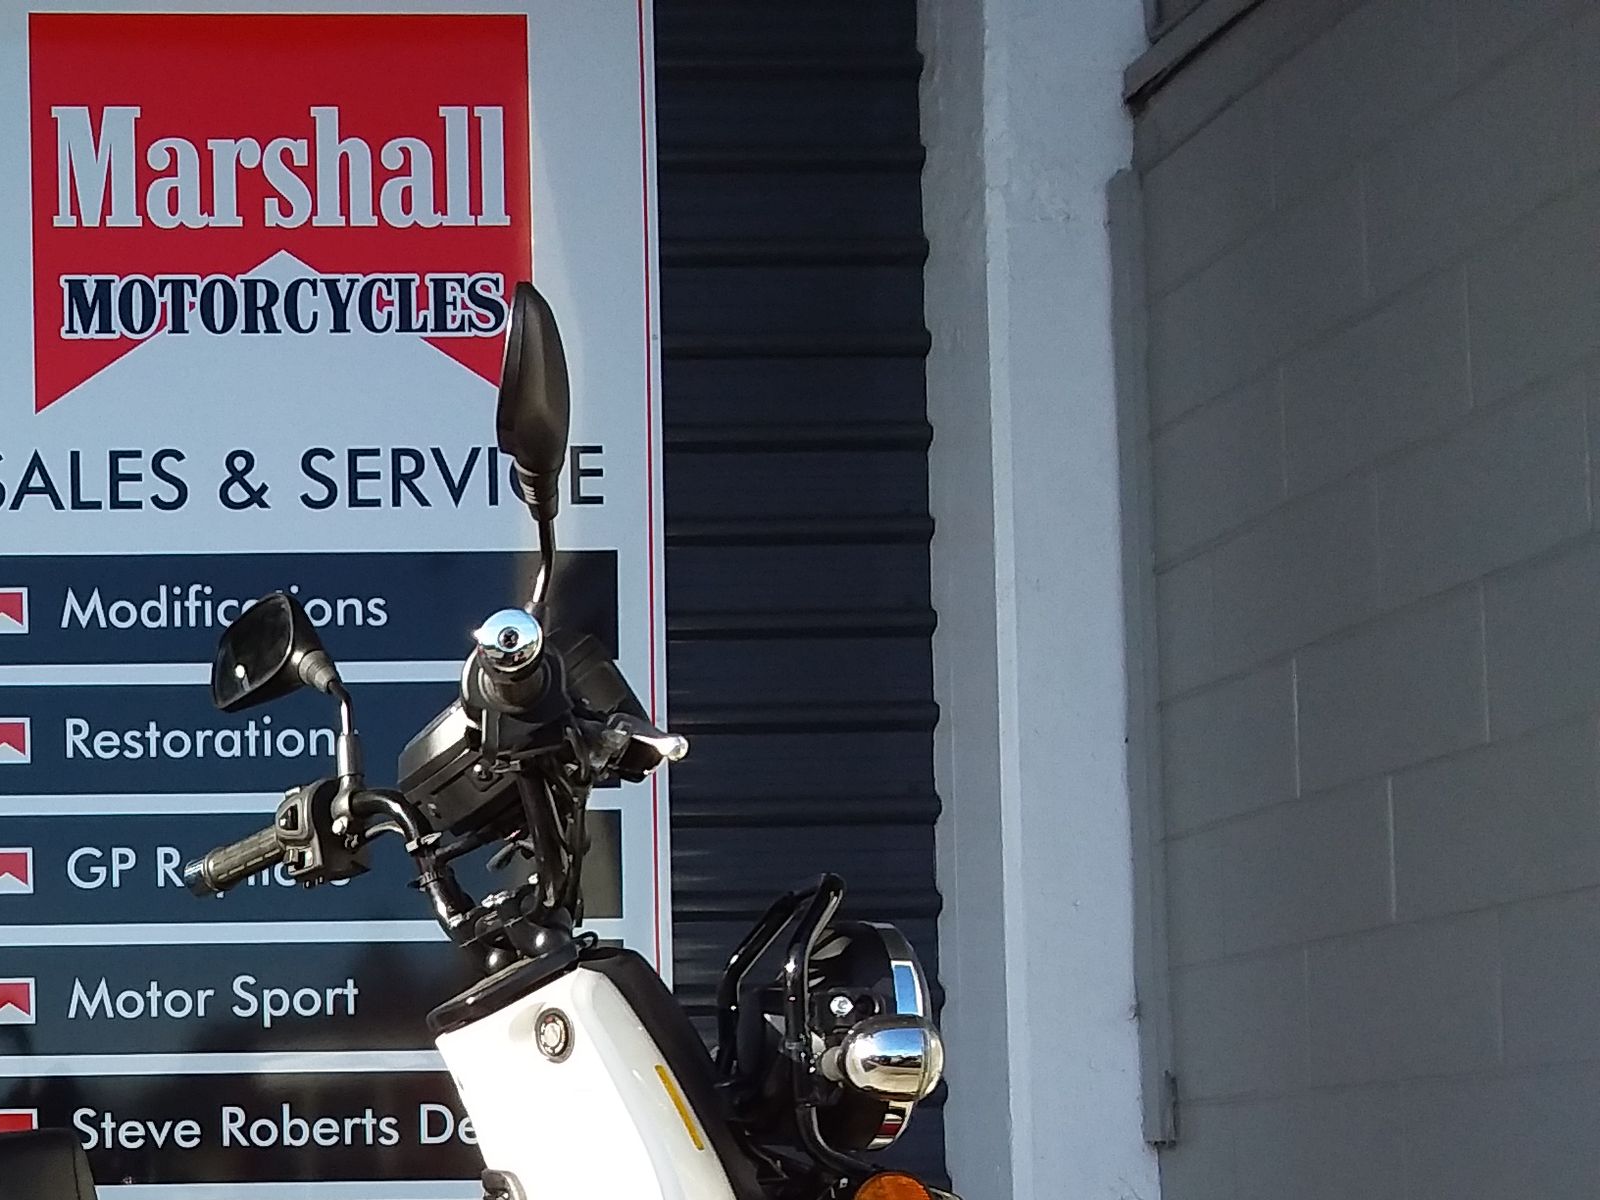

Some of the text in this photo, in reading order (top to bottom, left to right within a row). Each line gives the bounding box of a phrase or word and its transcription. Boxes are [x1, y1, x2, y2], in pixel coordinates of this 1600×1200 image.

[52, 105, 510, 229] Marshall
[61, 274, 507, 340] MOTORCYCLES
[219, 449, 271, 510] &
[299, 445, 604, 510] SERVIE
[60, 583, 388, 629] Modificons
[65, 715, 357, 759] Restoration
[67, 846, 136, 889] GP
[67, 974, 359, 1028] Motor Sport
[73, 1103, 478, 1150] Steve Roberts De
